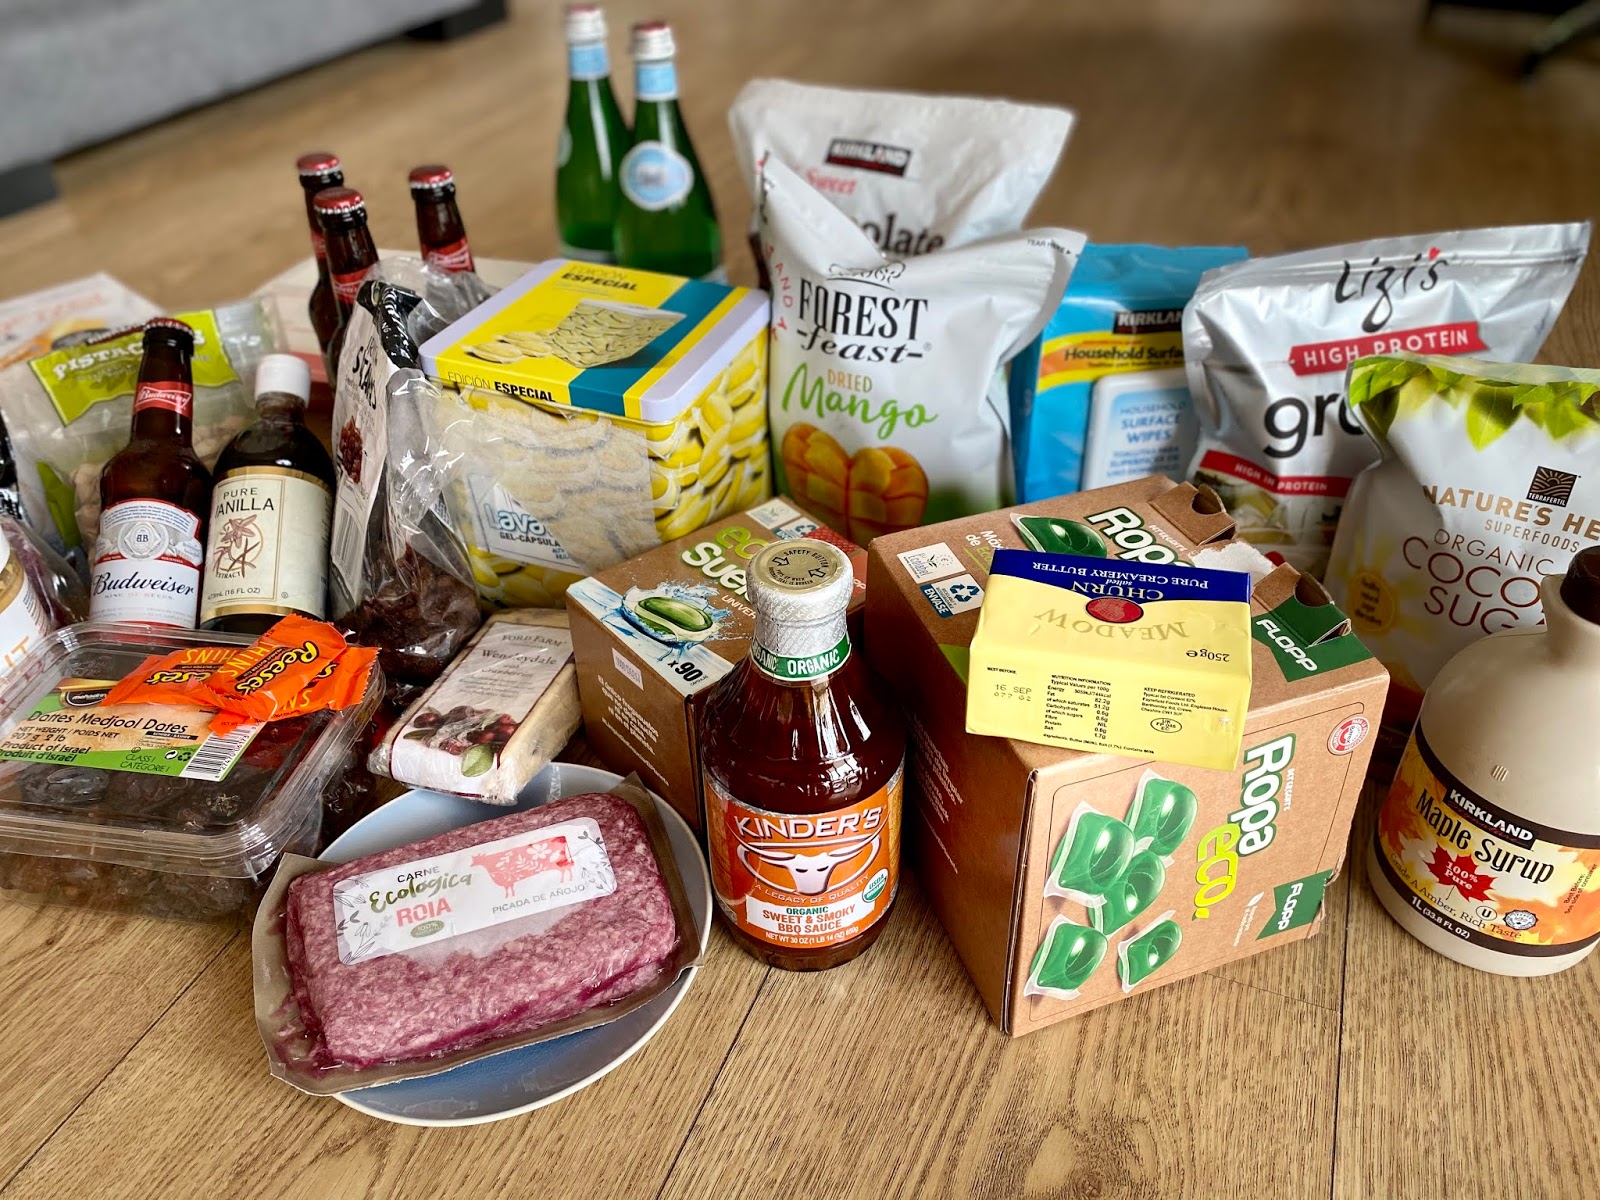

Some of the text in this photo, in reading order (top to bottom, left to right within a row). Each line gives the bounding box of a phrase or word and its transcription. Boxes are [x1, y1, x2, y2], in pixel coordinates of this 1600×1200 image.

[851, 213, 946, 255] olate
[561, 272, 638, 292] ESPECIAL
[1334, 245, 1454, 334] Lizi's
[799, 277, 929, 342] FOREST
[1064, 346, 1145, 362] Household
[1304, 328, 1470, 368] HIGH PROTEIN
[447, 371, 556, 403] EDICIÓN ESPECIAL
[827, 368, 873, 394] DRIED
[139, 389, 191, 407] Budweiser
[781, 361, 937, 440] Mango
[1121, 413, 1181, 430] SURFACE
[1126, 427, 1172, 444] WIPES
[1234, 463, 1328, 492] HIGH IN PROTEIN
[223, 487, 259, 500] PURE
[1422, 485, 1554, 527] NATURE'S
[1528, 492, 1567, 507] TERRAFERTIL
[966, 534, 980, 547] de
[1084, 506, 1196, 567] Rop
[1484, 519, 1581, 554] SUPERFOODS
[811, 552, 829, 568] BUTTON
[1433, 528, 1555, 577] ORGANIC
[93, 571, 195, 596] Budweiser
[681, 541, 751, 604] Sue
[1032, 561, 1210, 589] PURE CREAMERY BUTTER
[1104, 578, 1133, 588] salted
[1402, 536, 1545, 614] COCO
[247, 586, 261, 594] OZ)
[924, 587, 949, 614] ENVASE
[1070, 580, 1164, 600] CHURN
[1424, 585, 1546, 636] SUG
[1032, 607, 1190, 643] MEADOW
[502, 634, 563, 648] FORD FARM
[1255, 617, 1319, 674] FLOPP
[233, 640, 320, 697] Reese's
[787, 648, 841, 676] ORGANIC
[1013, 686, 1032, 695] SEP
[1047, 685, 1065, 693] Energy
[28, 710, 75, 724] Dattes
[75, 713, 144, 730] Medjool
[142, 718, 190, 734] Dates
[35, 726, 68, 734] WEIGHT
[73, 729, 100, 737] POIDS
[101, 731, 121, 739] NET
[1, 741, 92, 755] Product of Israel
[12, 732, 32, 741] 907
[125, 753, 152, 763] CLASS
[1229, 733, 1295, 856] Ropa
[733, 807, 884, 839] KINDER'S
[1449, 788, 1534, 842] KIRKLAND
[1415, 788, 1555, 885] Maple Syrup
[396, 865, 441, 884] CARNE
[868, 873, 885, 890] USDA
[1444, 869, 1473, 890] Pure
[1445, 861, 1478, 883] 100%
[491, 883, 586, 915] PICADA DE AÑOJO
[764, 889, 808, 904] LEGACY
[810, 896, 825, 904] OF
[828, 874, 870, 901] QUALITY
[1390, 852, 1411, 880] Grade
[1410, 879, 1419, 890] A
[1419, 886, 1457, 917] Amber,
[1459, 911, 1487, 929] Rich
[1490, 923, 1522, 939] Taste
[396, 896, 453, 929] ROIA
[762, 904, 856, 924] SWEET & SMOKY
[786, 906, 829, 916] ORGANIC
[1277, 882, 1304, 931] FLOPP
[1411, 895, 1471, 940] 1L (33.8 FL OZ)
[765, 932, 778, 941] NET
[778, 934, 789, 942] WT
[816, 935, 826, 943] LB
[777, 919, 842, 934] BBQ SAUCE
